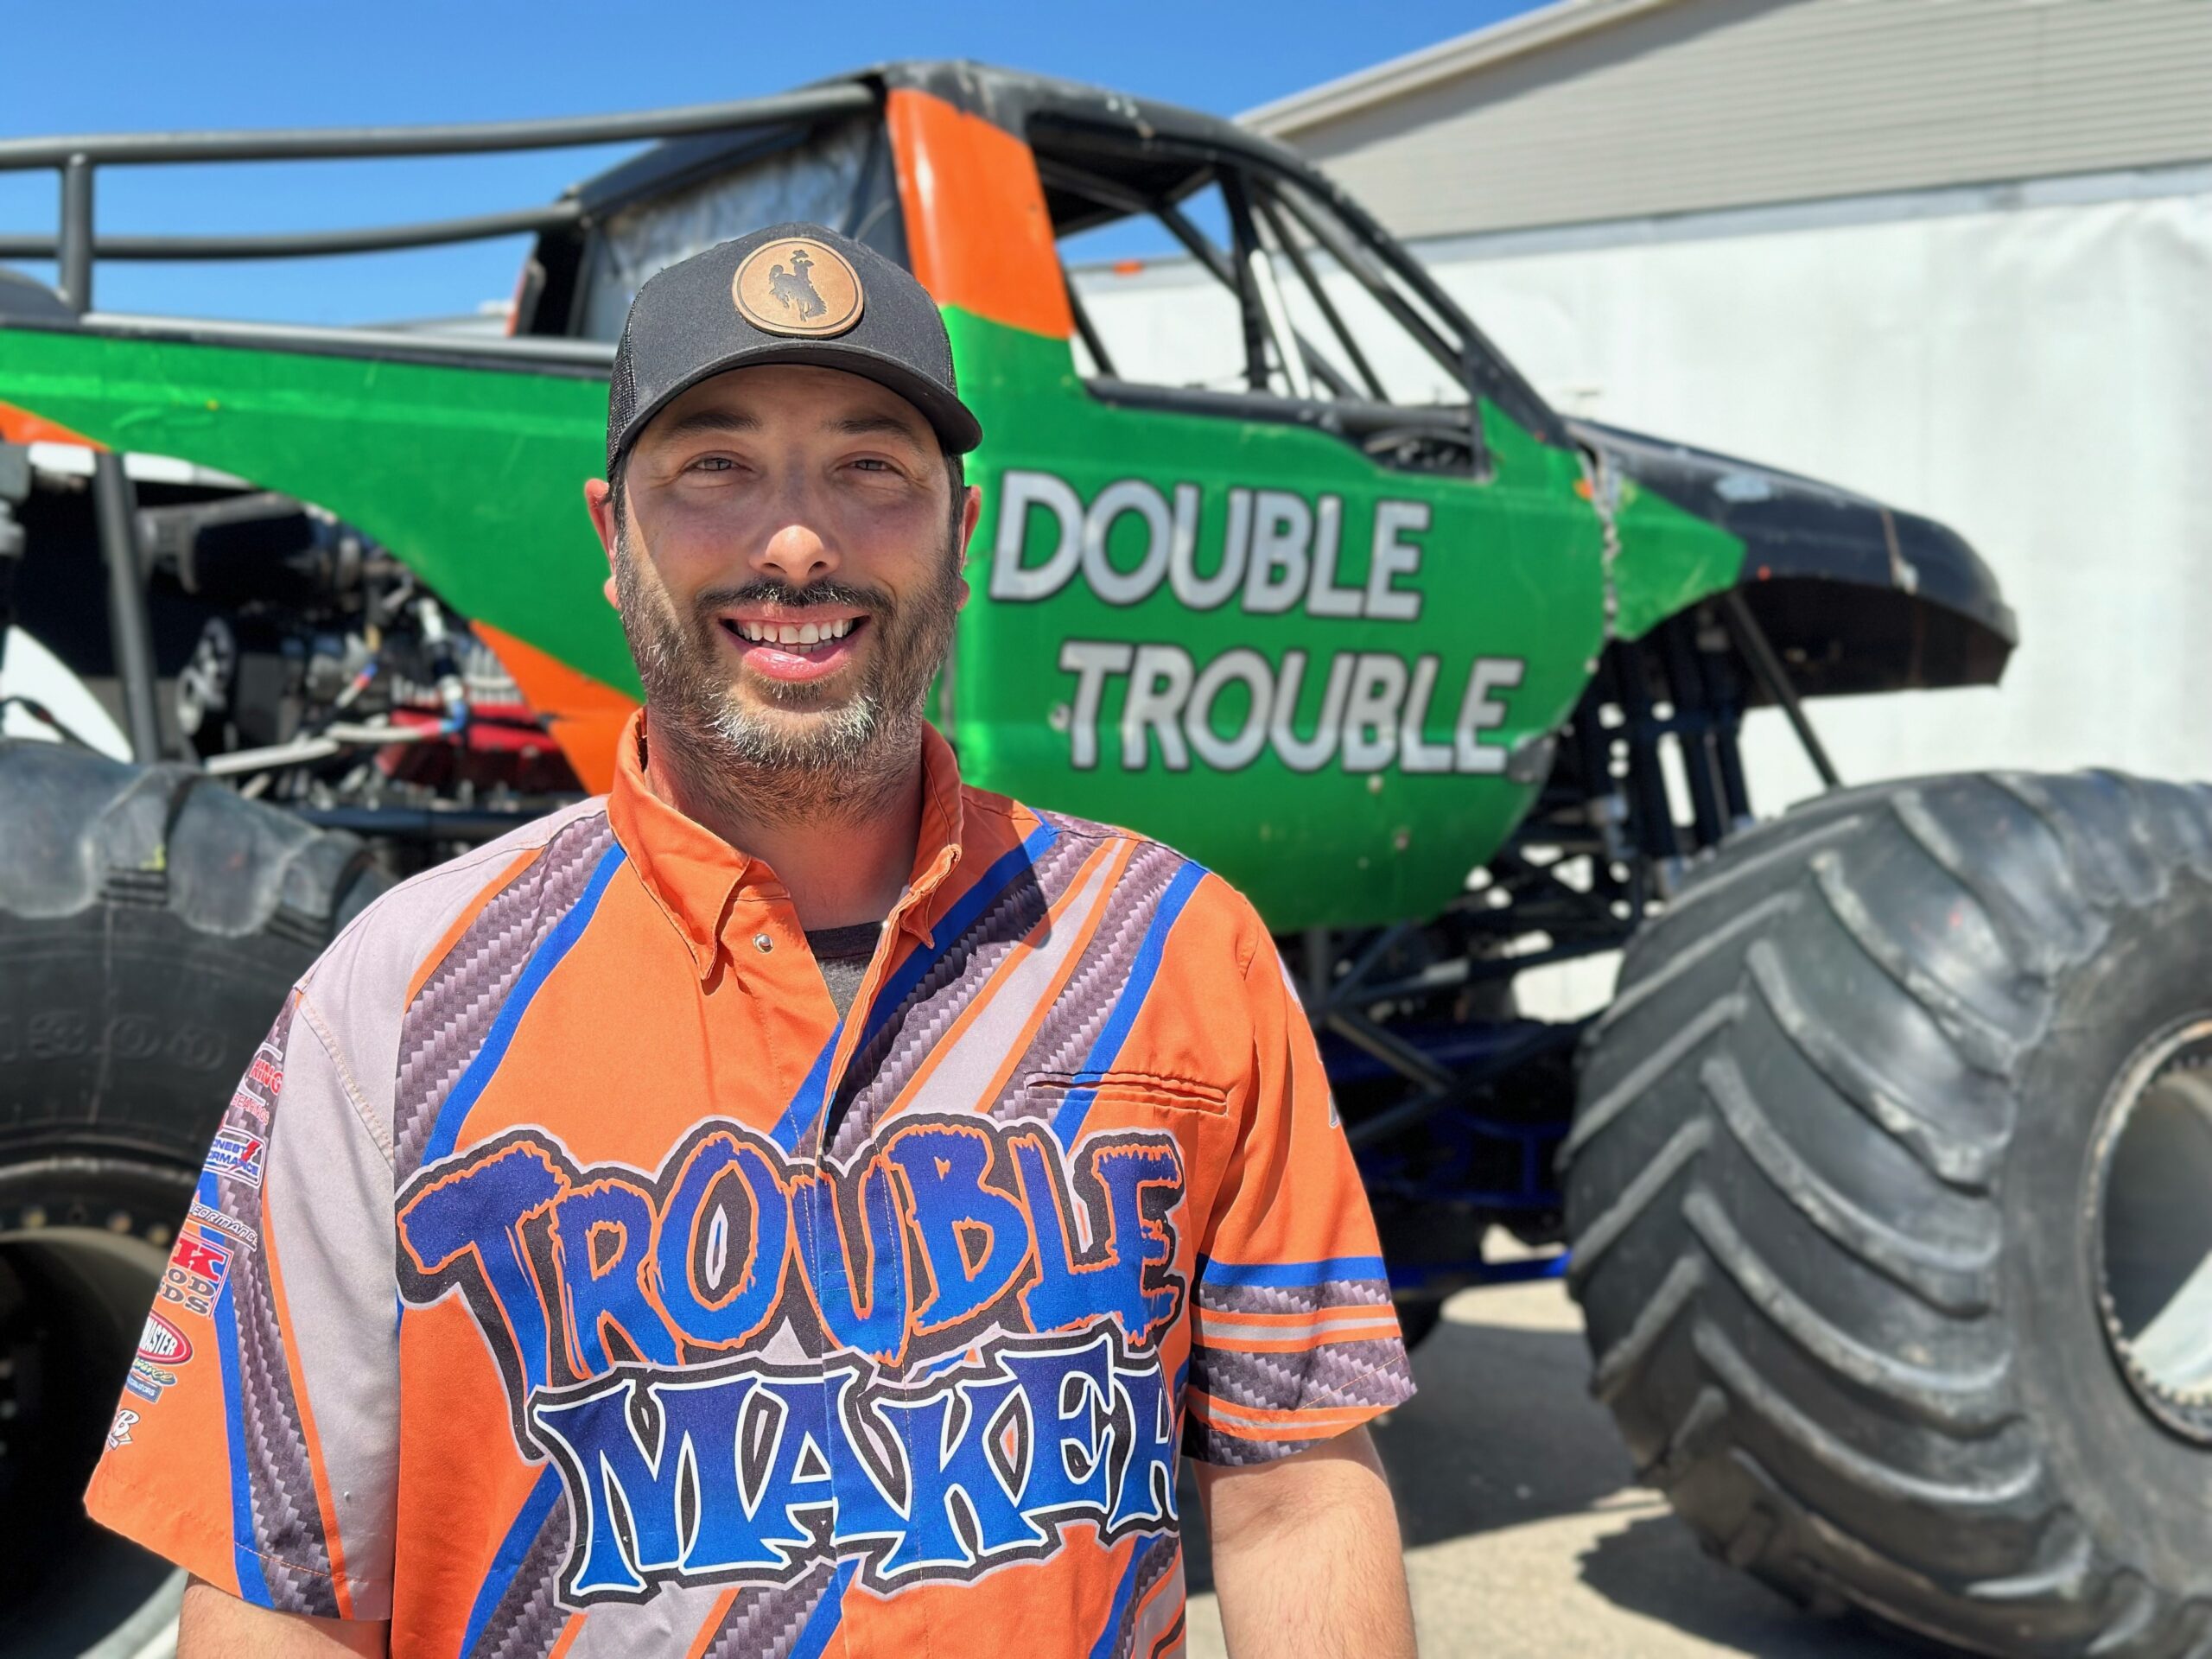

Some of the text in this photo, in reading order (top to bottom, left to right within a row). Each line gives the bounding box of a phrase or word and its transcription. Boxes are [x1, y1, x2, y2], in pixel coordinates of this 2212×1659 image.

[988, 470, 1432, 620] DOUBLE
[1058, 640, 1524, 772] TROUBLE
[168, 1268, 216, 1298] OD
[190, 1202, 258, 1246] FORMANCE
[397, 1120, 1185, 1391] TROUBLE
[529, 1335, 1179, 1595] MAKER
